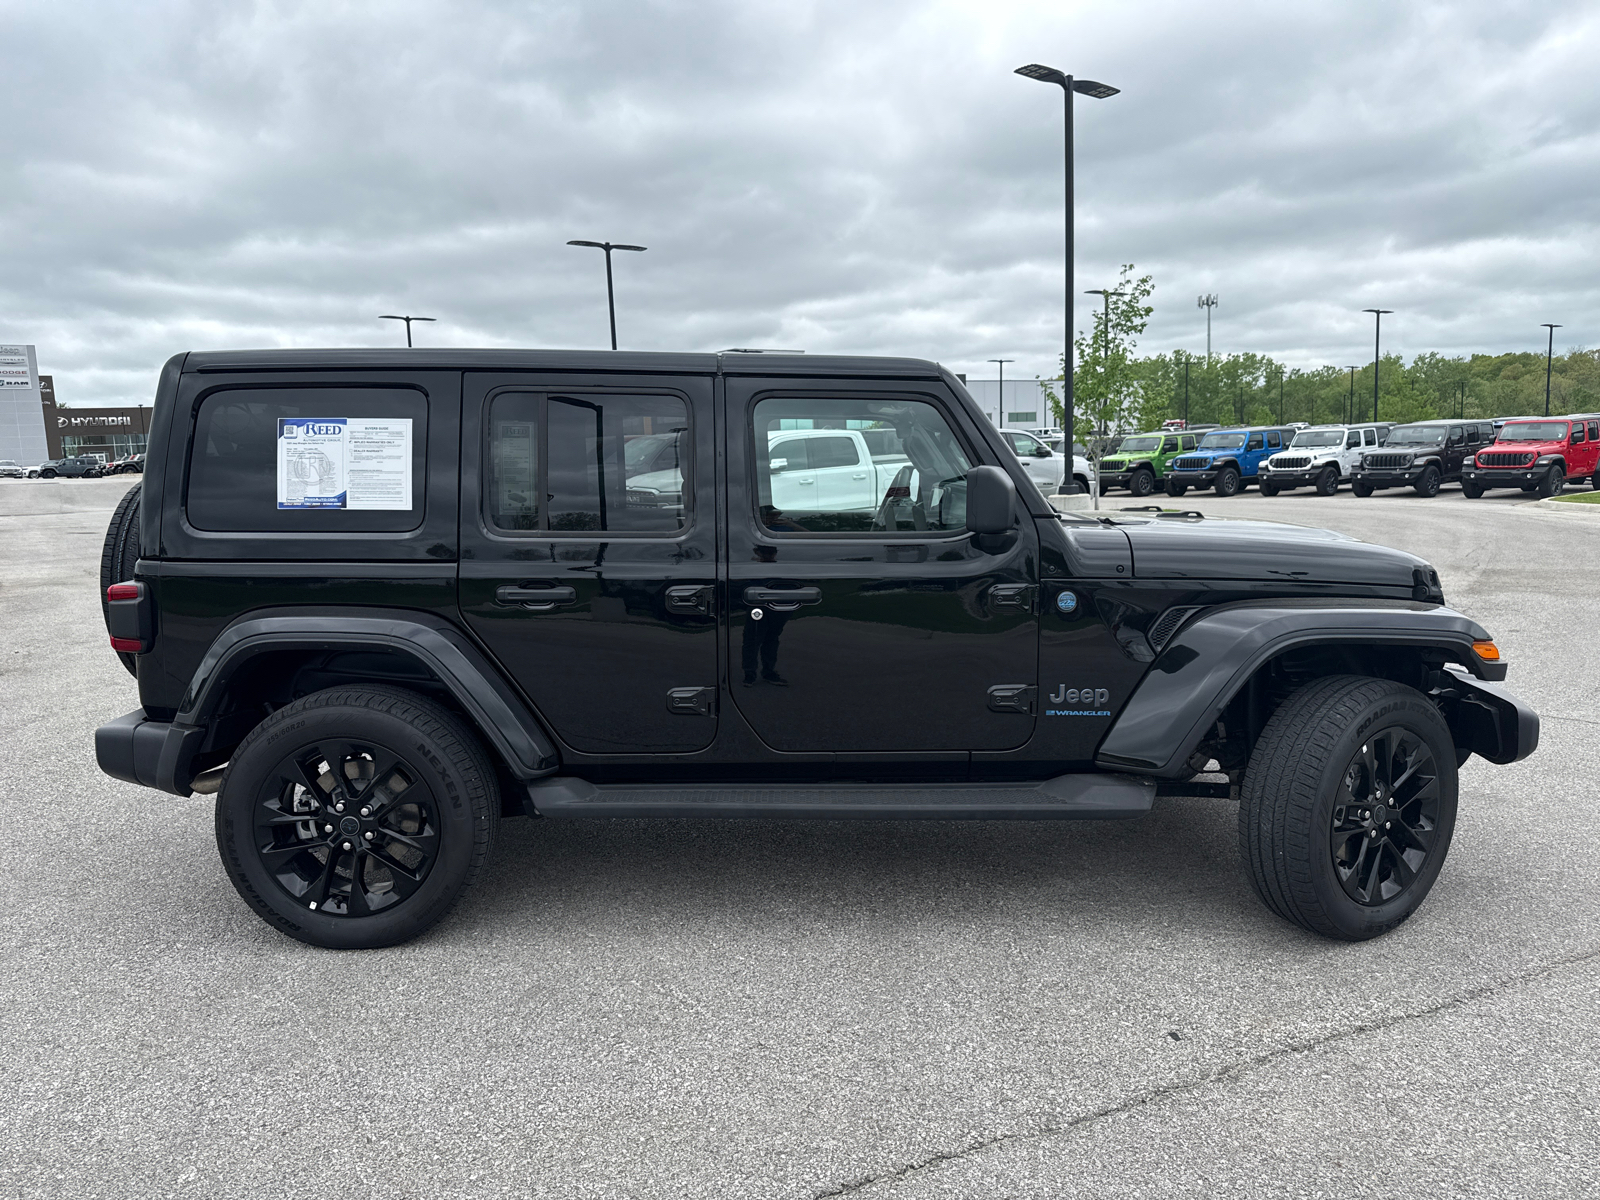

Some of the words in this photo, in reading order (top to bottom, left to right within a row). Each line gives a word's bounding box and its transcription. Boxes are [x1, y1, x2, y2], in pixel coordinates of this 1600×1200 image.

[71, 416, 131, 427] HYUNDAI
[305, 423, 342, 435] REED
[1049, 683, 1110, 707] Jeep
[266, 719, 306, 746] 255/60R20
[1356, 700, 1407, 739] ROADIAN
[416, 743, 463, 810] NEXEN
[237, 872, 303, 932] ROADIAN
